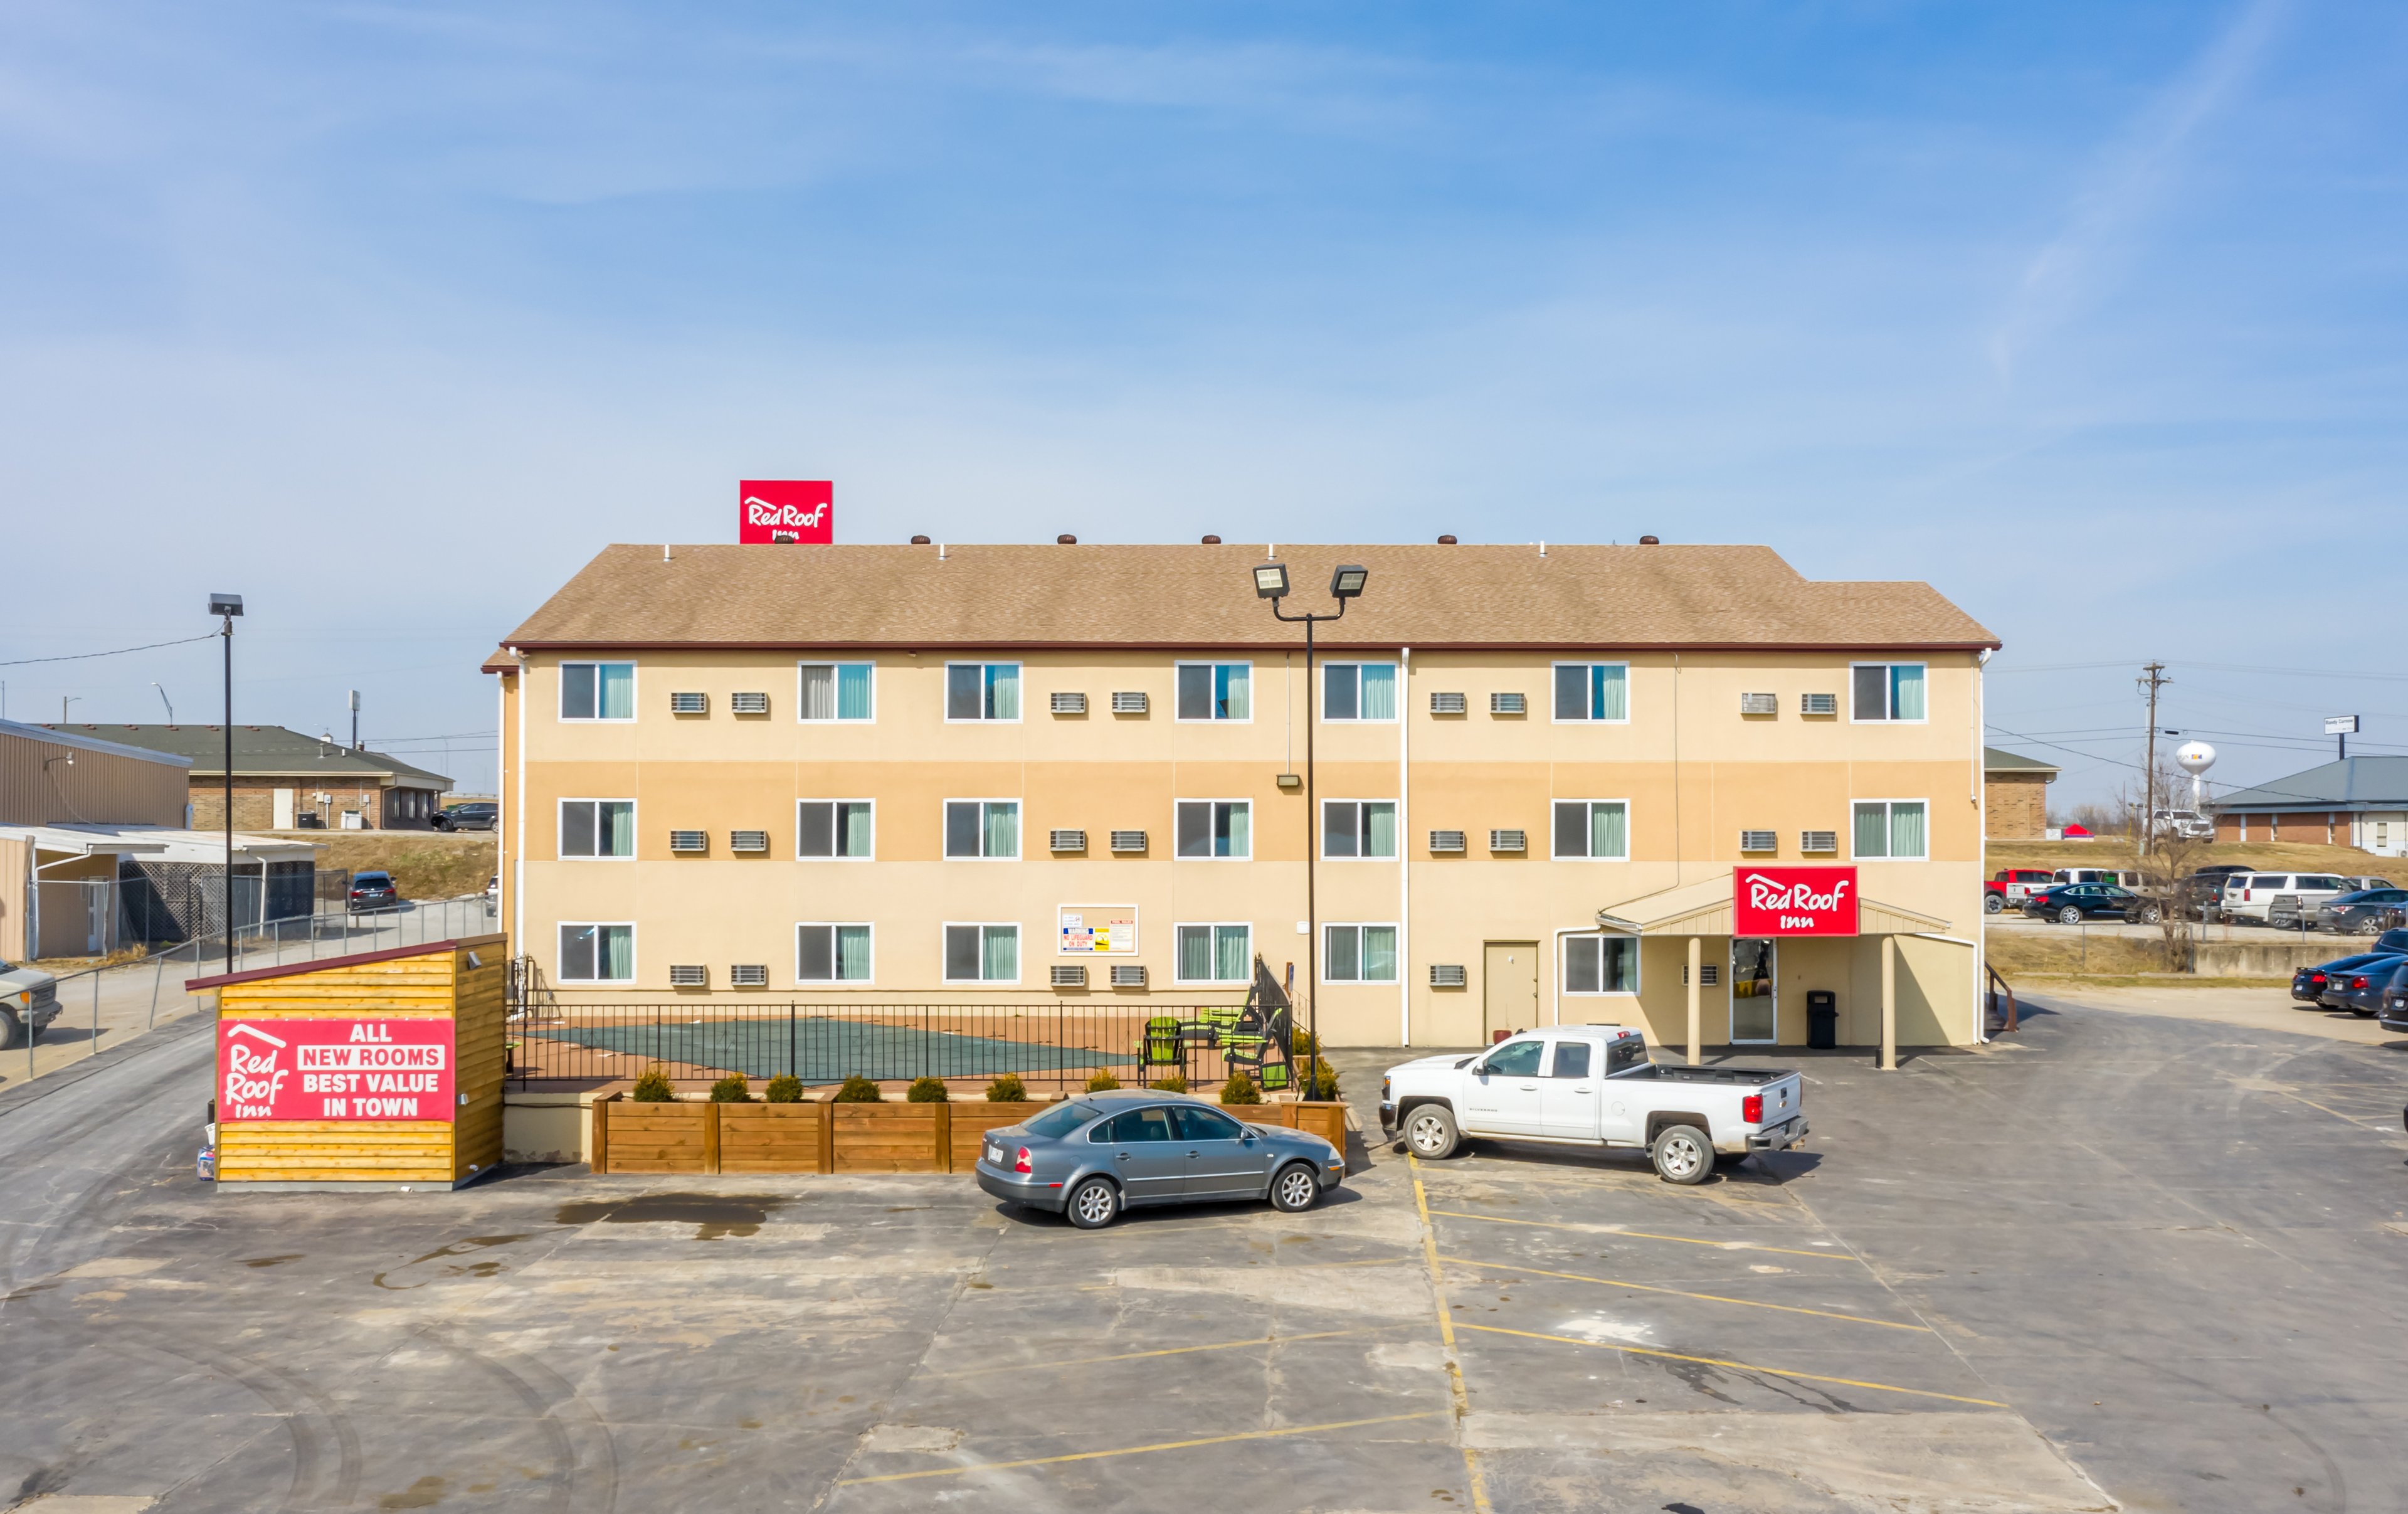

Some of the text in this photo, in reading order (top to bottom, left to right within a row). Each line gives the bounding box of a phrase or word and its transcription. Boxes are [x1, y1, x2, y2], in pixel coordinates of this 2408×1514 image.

[749, 503, 827, 527] Red Roof
[1751, 880, 1849, 912] Red Roof
[349, 1024, 393, 1042] ALL
[231, 1044, 278, 1075] Red
[304, 1048, 439, 1066] NEW ROOMS
[225, 1069, 289, 1106] Roof
[304, 1073, 438, 1093] BEST VALUE
[324, 1098, 418, 1117] IN TOWN
